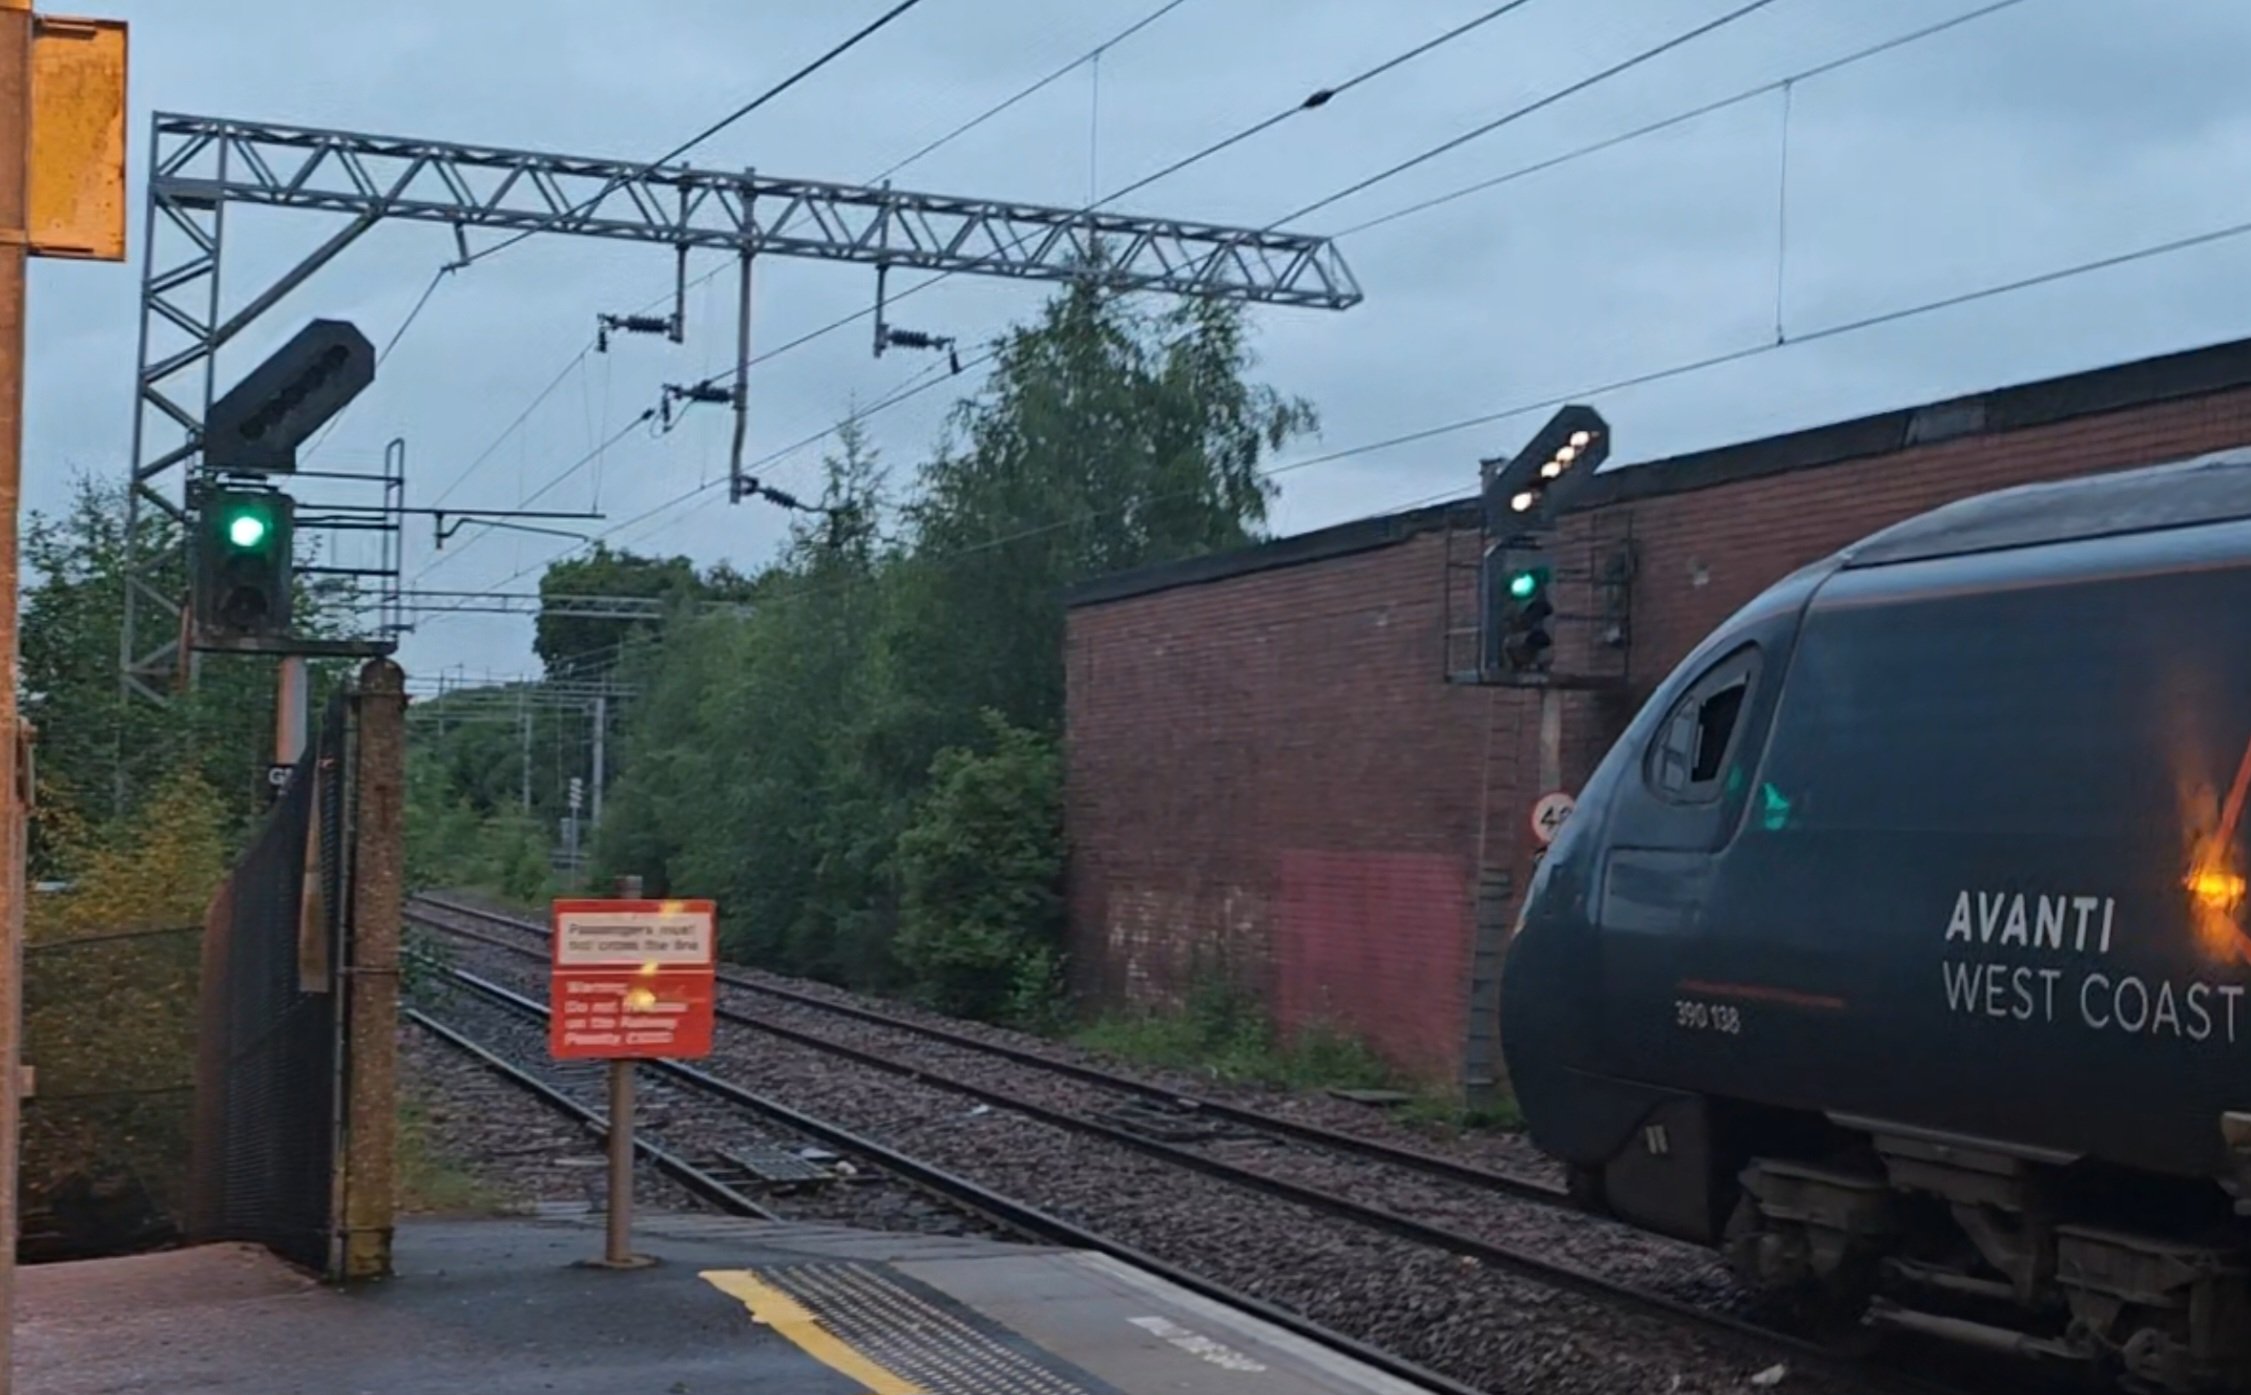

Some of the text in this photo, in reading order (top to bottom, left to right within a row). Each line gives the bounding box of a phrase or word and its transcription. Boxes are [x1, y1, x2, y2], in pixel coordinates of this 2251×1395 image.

[1945, 890, 2115, 953] AVANTI
[1675, 1000, 1740, 1035] 390 138
[1943, 960, 2245, 1043] WEST COAST
